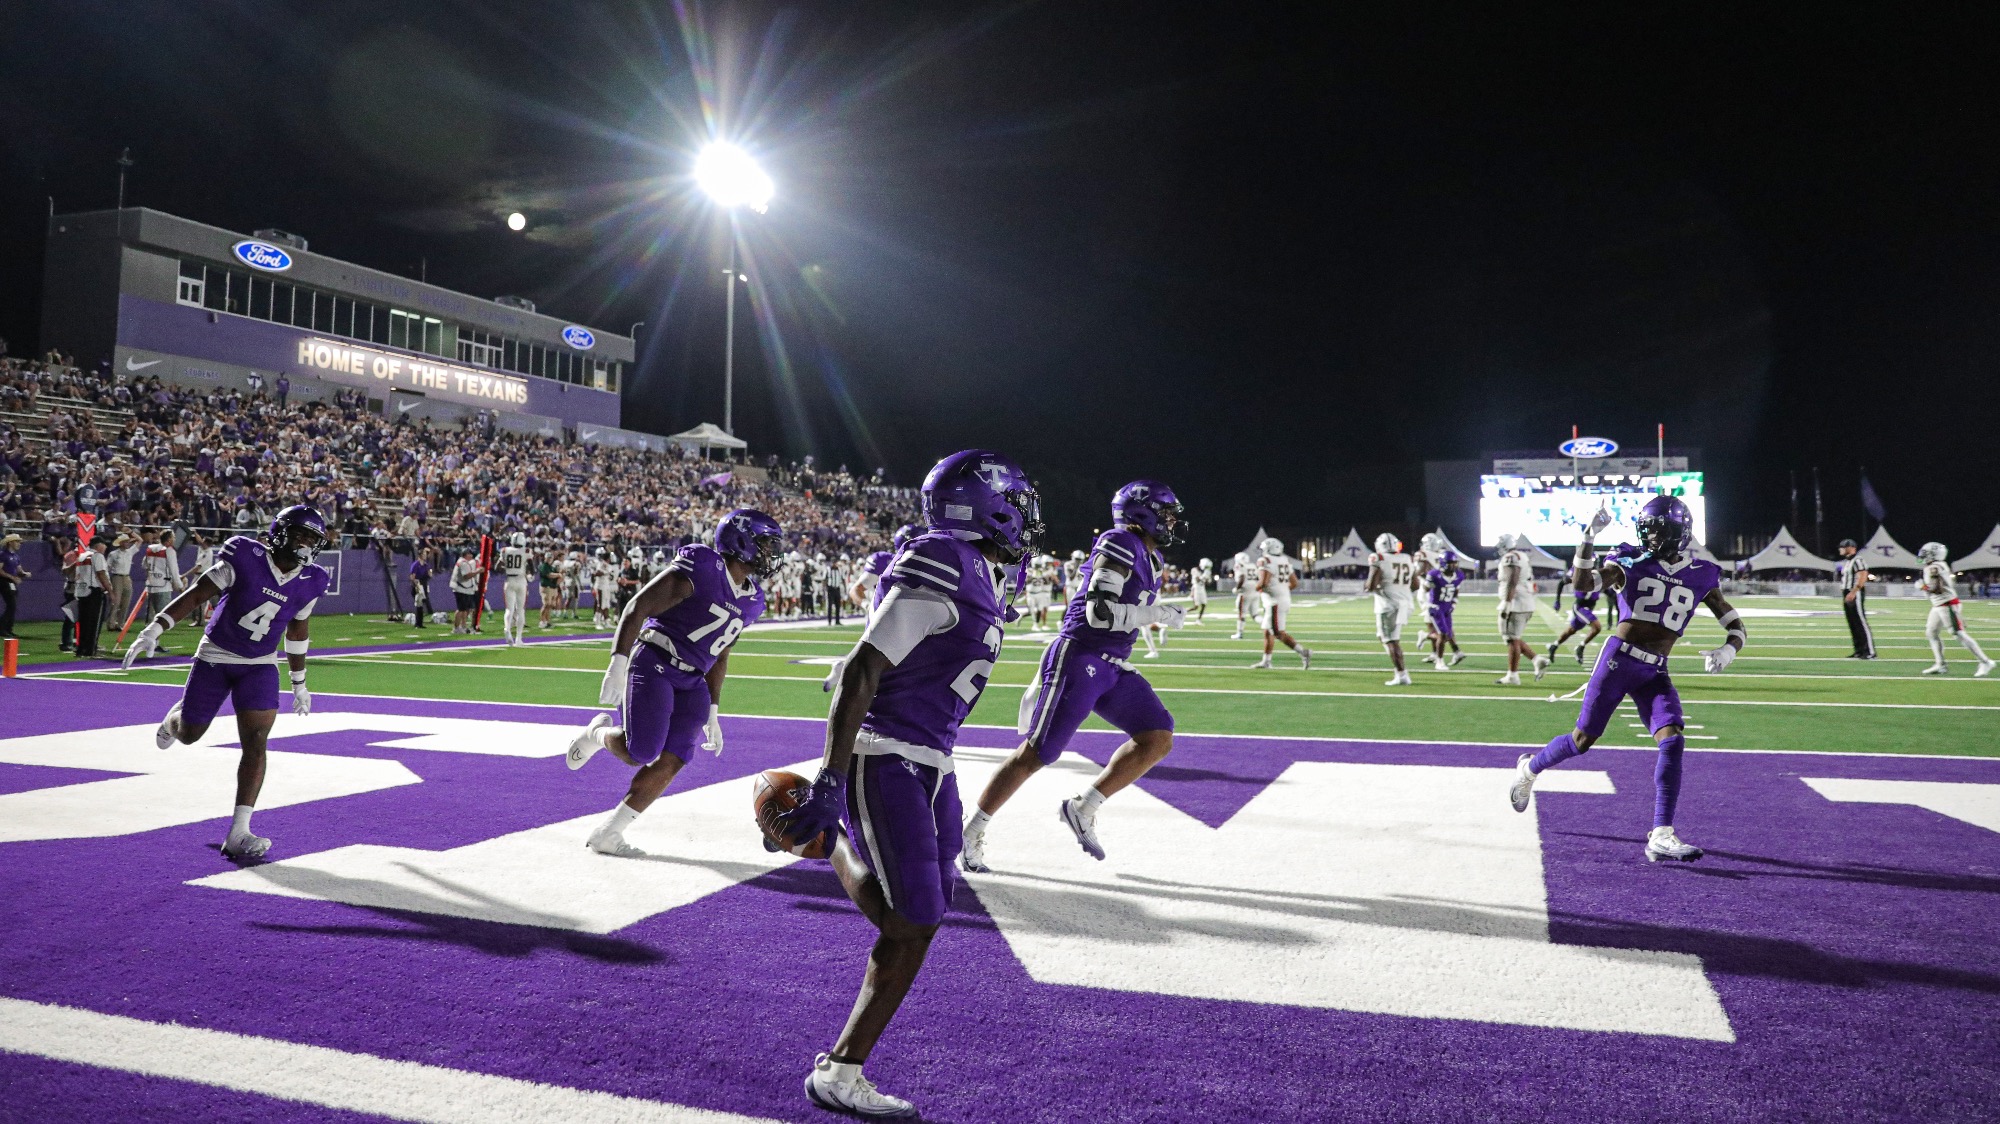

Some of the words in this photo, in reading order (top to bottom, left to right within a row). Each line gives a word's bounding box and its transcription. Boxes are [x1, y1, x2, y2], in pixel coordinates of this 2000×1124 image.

[247, 243, 282, 268] Ford
[568, 329, 590, 346] Ford
[298, 341, 365, 376] HOME
[373, 356, 401, 381] OF
[409, 364, 448, 390] THE
[455, 372, 528, 405] TEXANS
[1570, 439, 1607, 456] Ford
[506, 554, 522, 569] 80
[1392, 562, 1410, 584] 72
[1656, 573, 1683, 585] TEXANS
[262, 586, 288, 603] TEXANS
[1631, 576, 1695, 632] 28
[725, 601, 742, 616] TEXANS
[237, 600, 282, 642] 4
[687, 602, 744, 657] 78
